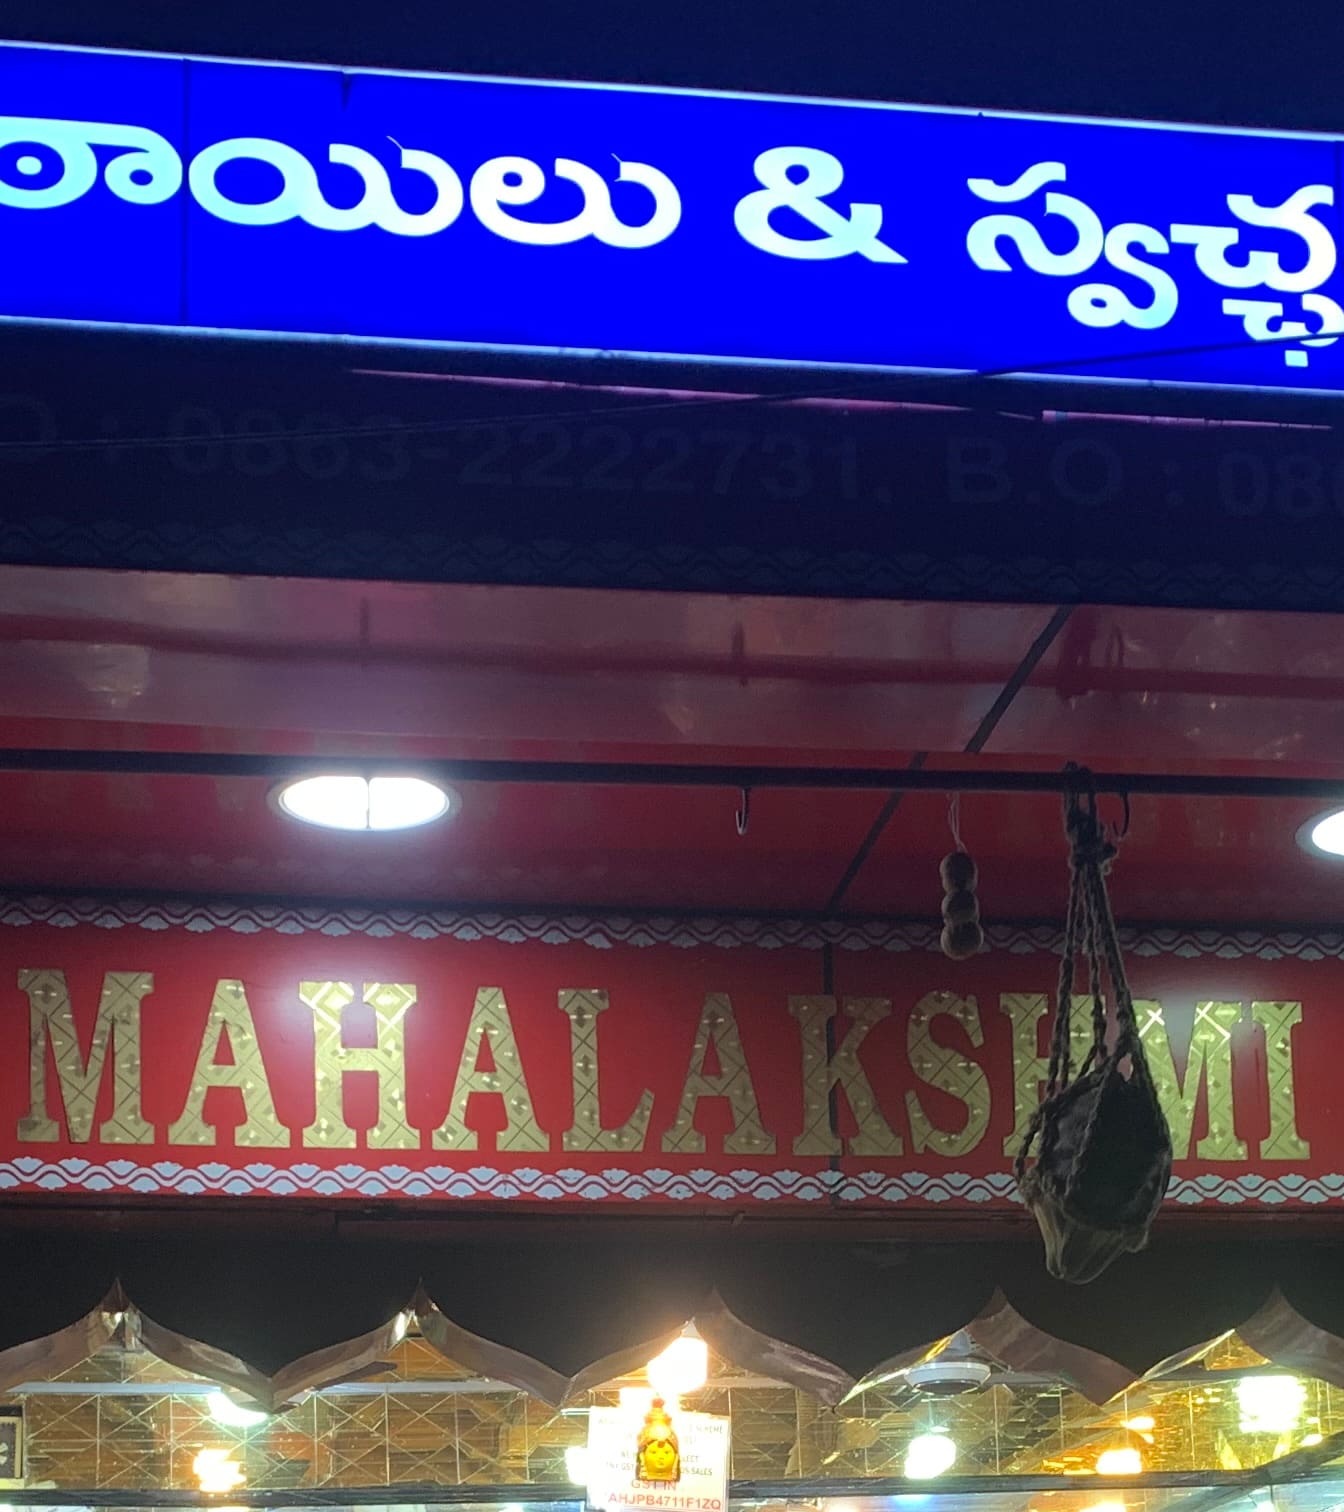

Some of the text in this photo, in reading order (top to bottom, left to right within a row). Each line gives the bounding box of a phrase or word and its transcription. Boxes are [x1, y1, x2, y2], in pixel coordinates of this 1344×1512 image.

[734, 147, 908, 263] &
[17, 966, 1311, 1164] MAHALAKSHMI
[631, 1480, 657, 1490] GST
